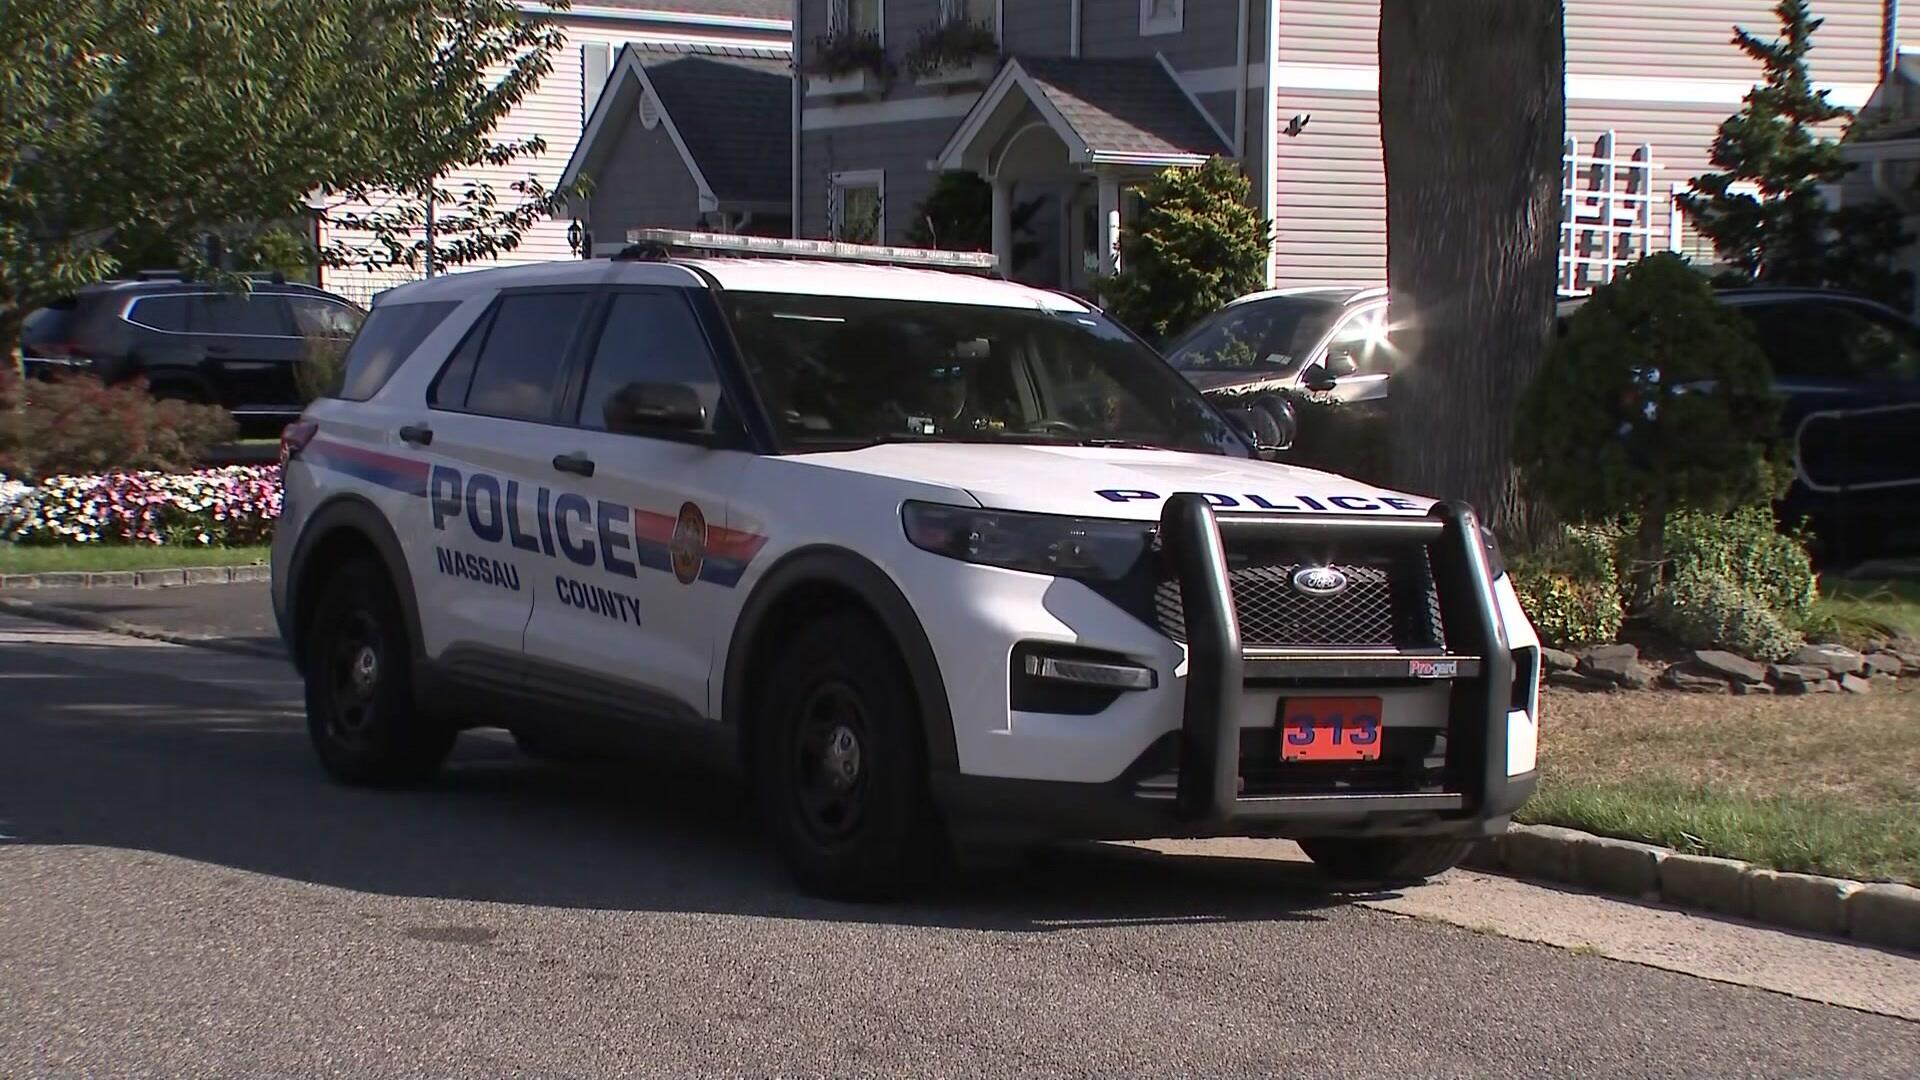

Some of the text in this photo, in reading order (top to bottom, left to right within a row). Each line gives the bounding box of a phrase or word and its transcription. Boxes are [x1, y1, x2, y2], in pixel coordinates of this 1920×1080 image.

[431, 465, 638, 579] POLICE
[436, 546, 642, 627] NASSAU COUNTY
[1304, 570, 1339, 589] Ford
[1287, 714, 1378, 746] 313
